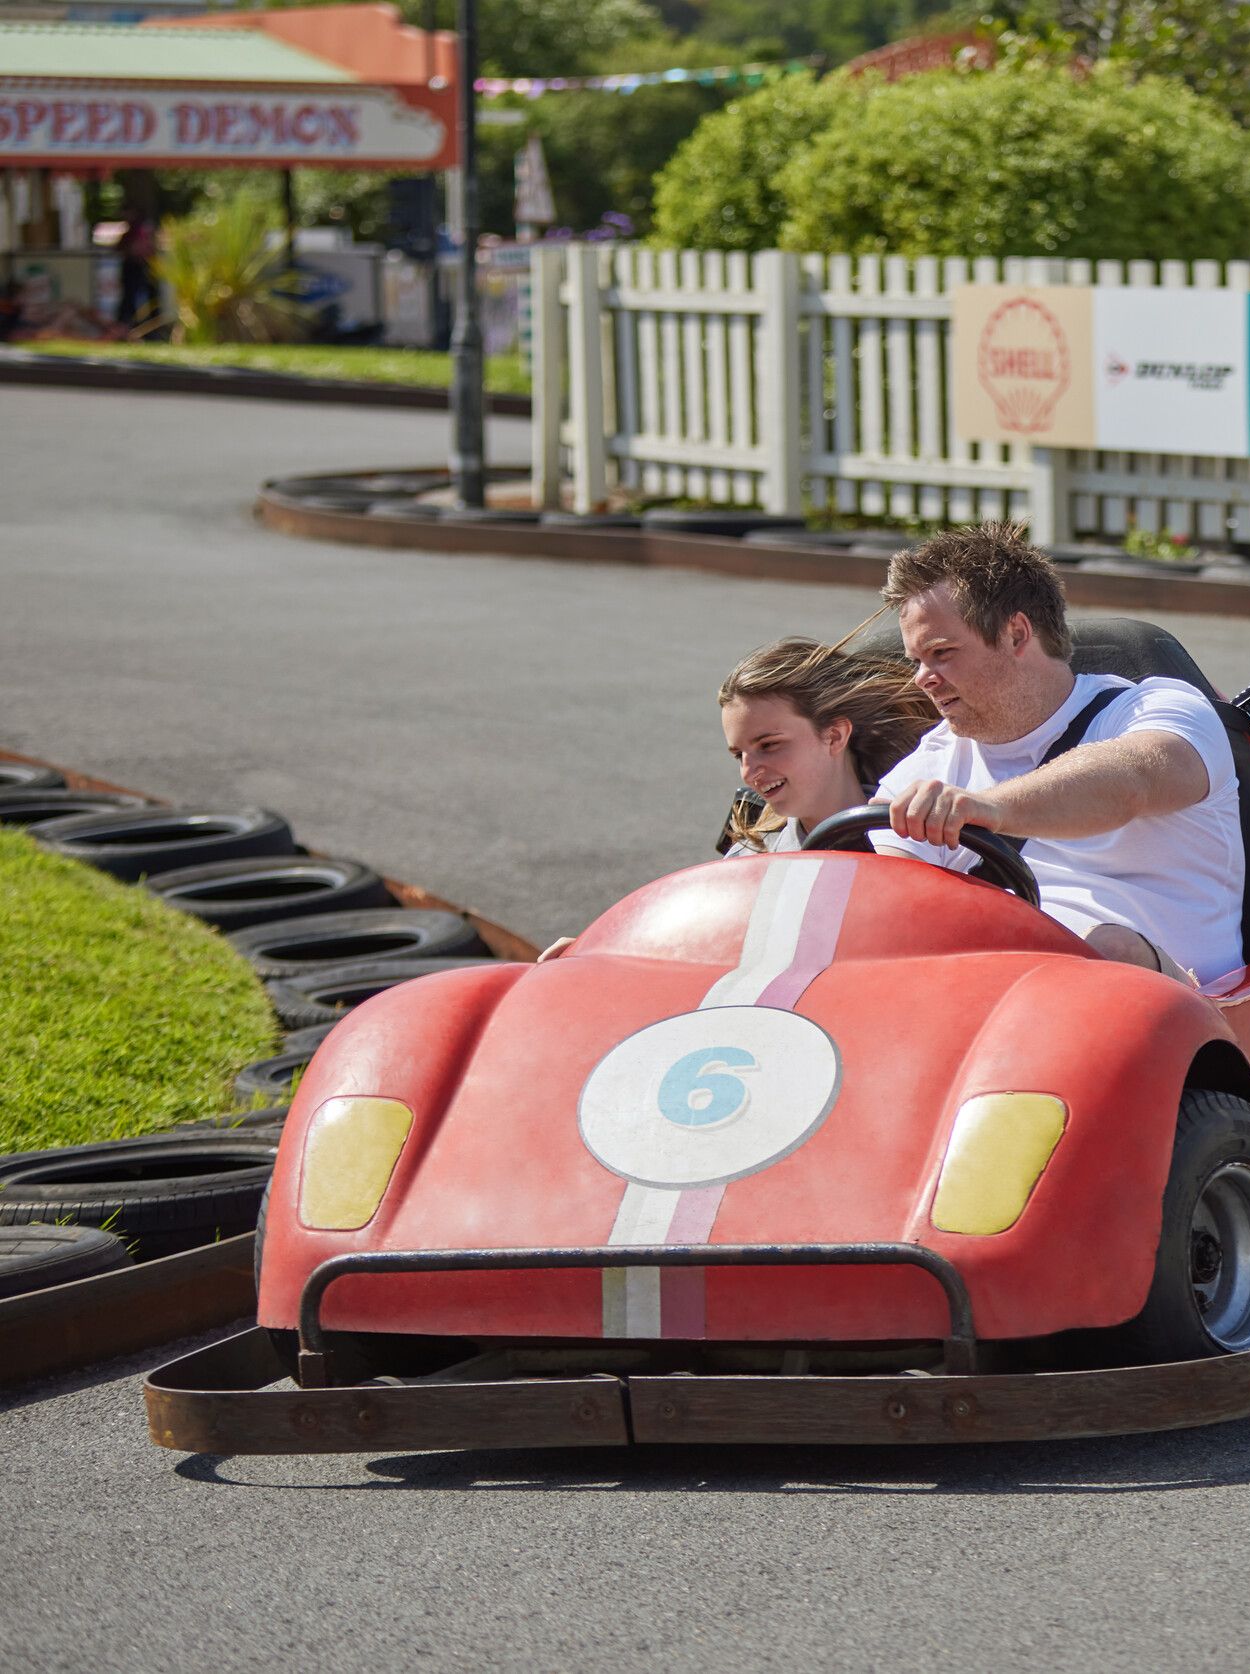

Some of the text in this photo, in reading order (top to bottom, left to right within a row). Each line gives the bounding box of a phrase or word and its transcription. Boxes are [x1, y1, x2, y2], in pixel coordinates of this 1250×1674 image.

[172, 102, 361, 149] DEMON
[990, 347, 1056, 380] SHELL
[656, 1046, 761, 1134] 6
